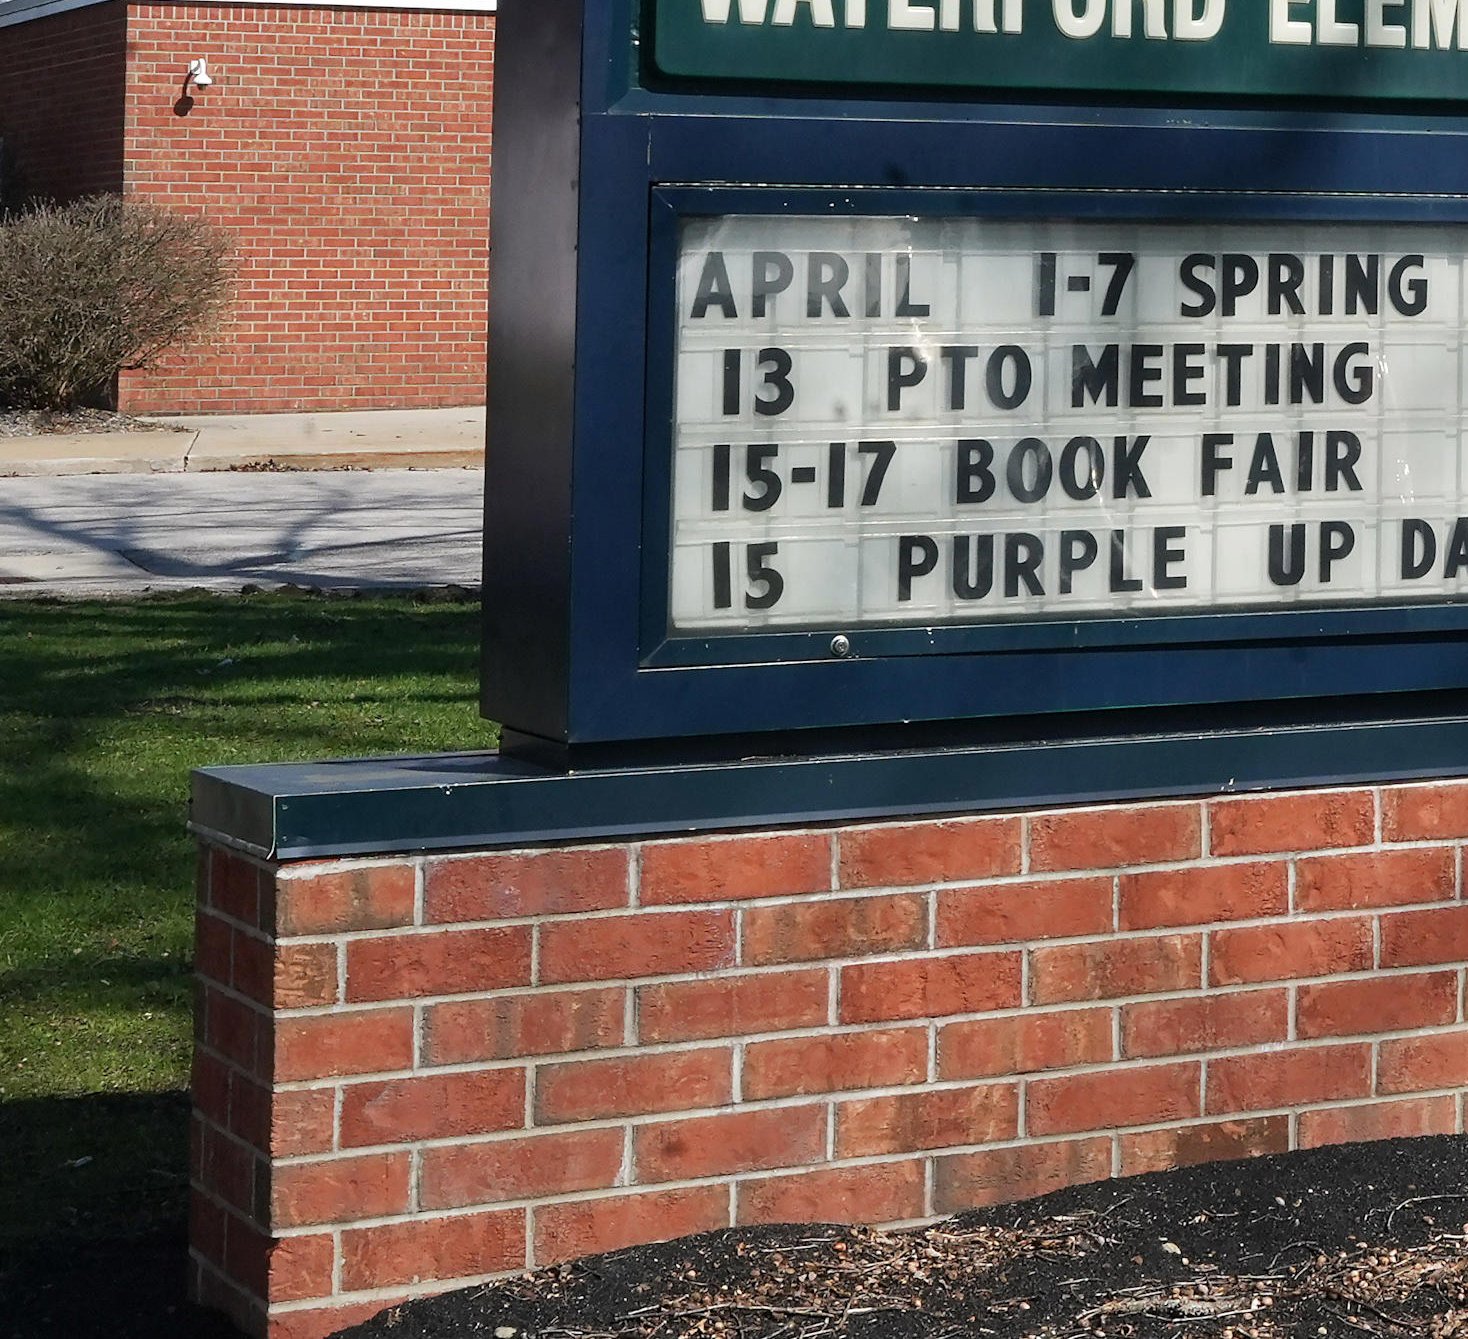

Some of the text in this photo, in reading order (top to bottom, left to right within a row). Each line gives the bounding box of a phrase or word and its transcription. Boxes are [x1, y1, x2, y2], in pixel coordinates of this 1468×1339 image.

[690, 251, 930, 318] APRIL
[1038, 252, 1136, 316] 1-7
[1178, 254, 1428, 316] SPRING
[723, 342, 1374, 415] 13 PTO MEETING
[711, 430, 1363, 511] 15-17 BOOK FAIR
[712, 541, 783, 609] 15
[898, 527, 1186, 601] PURPLE
[1268, 521, 1355, 585] UP
